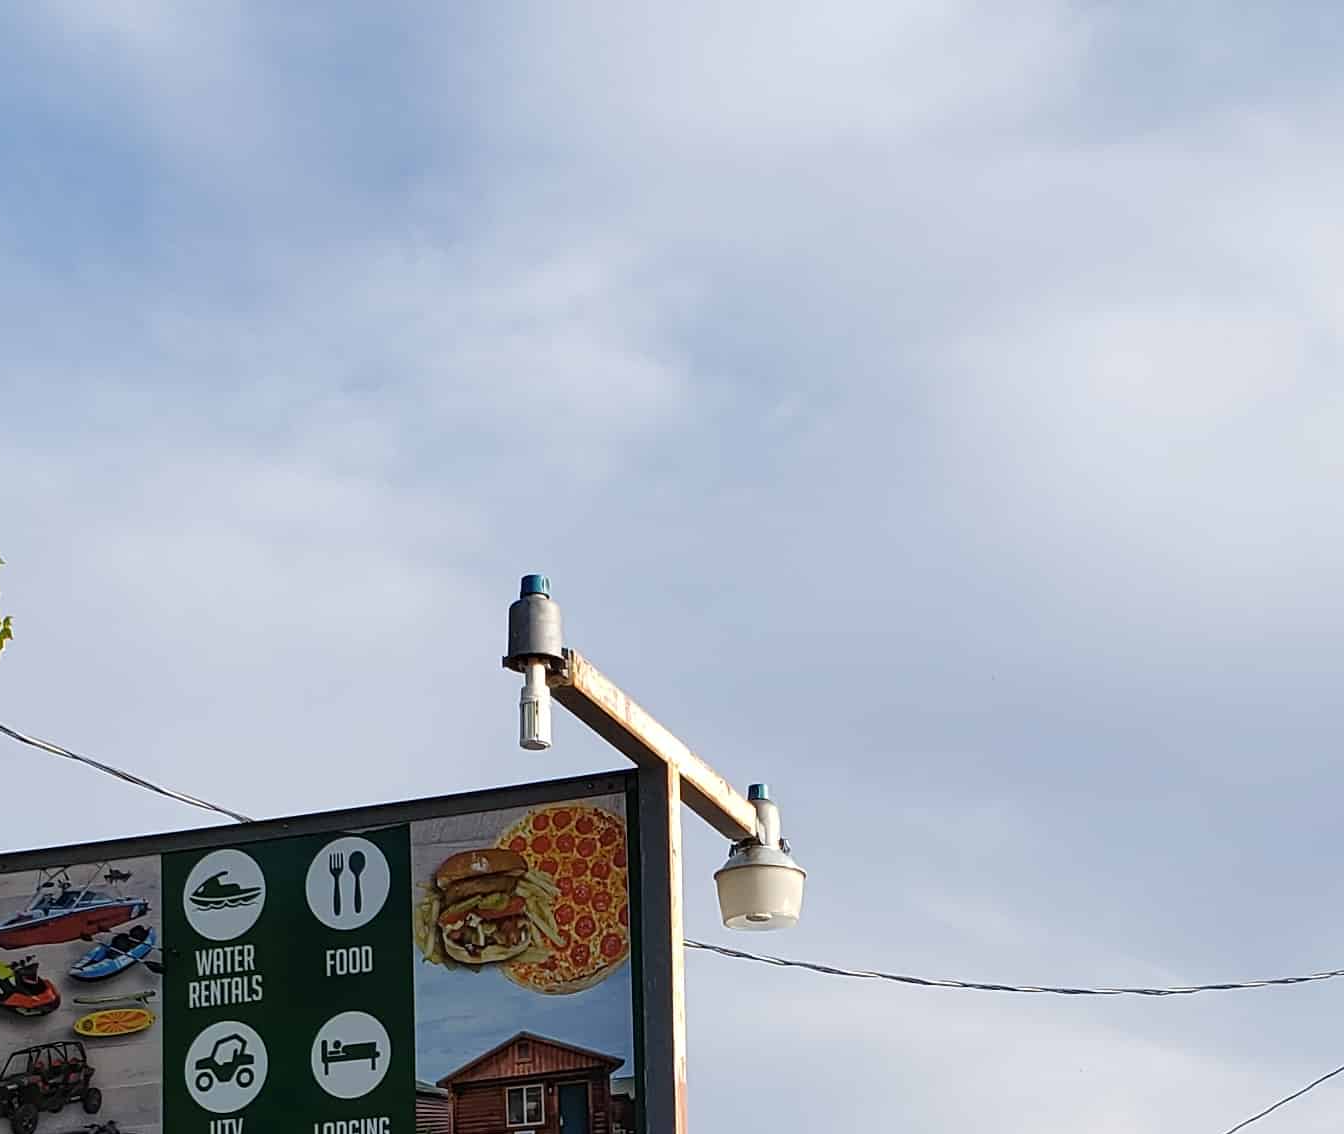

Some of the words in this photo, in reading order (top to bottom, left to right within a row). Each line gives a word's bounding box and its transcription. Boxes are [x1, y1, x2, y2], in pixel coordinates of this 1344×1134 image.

[195, 944, 255, 977] WATER
[326, 946, 373, 977] FOOD
[188, 974, 263, 1009] RENTALS
